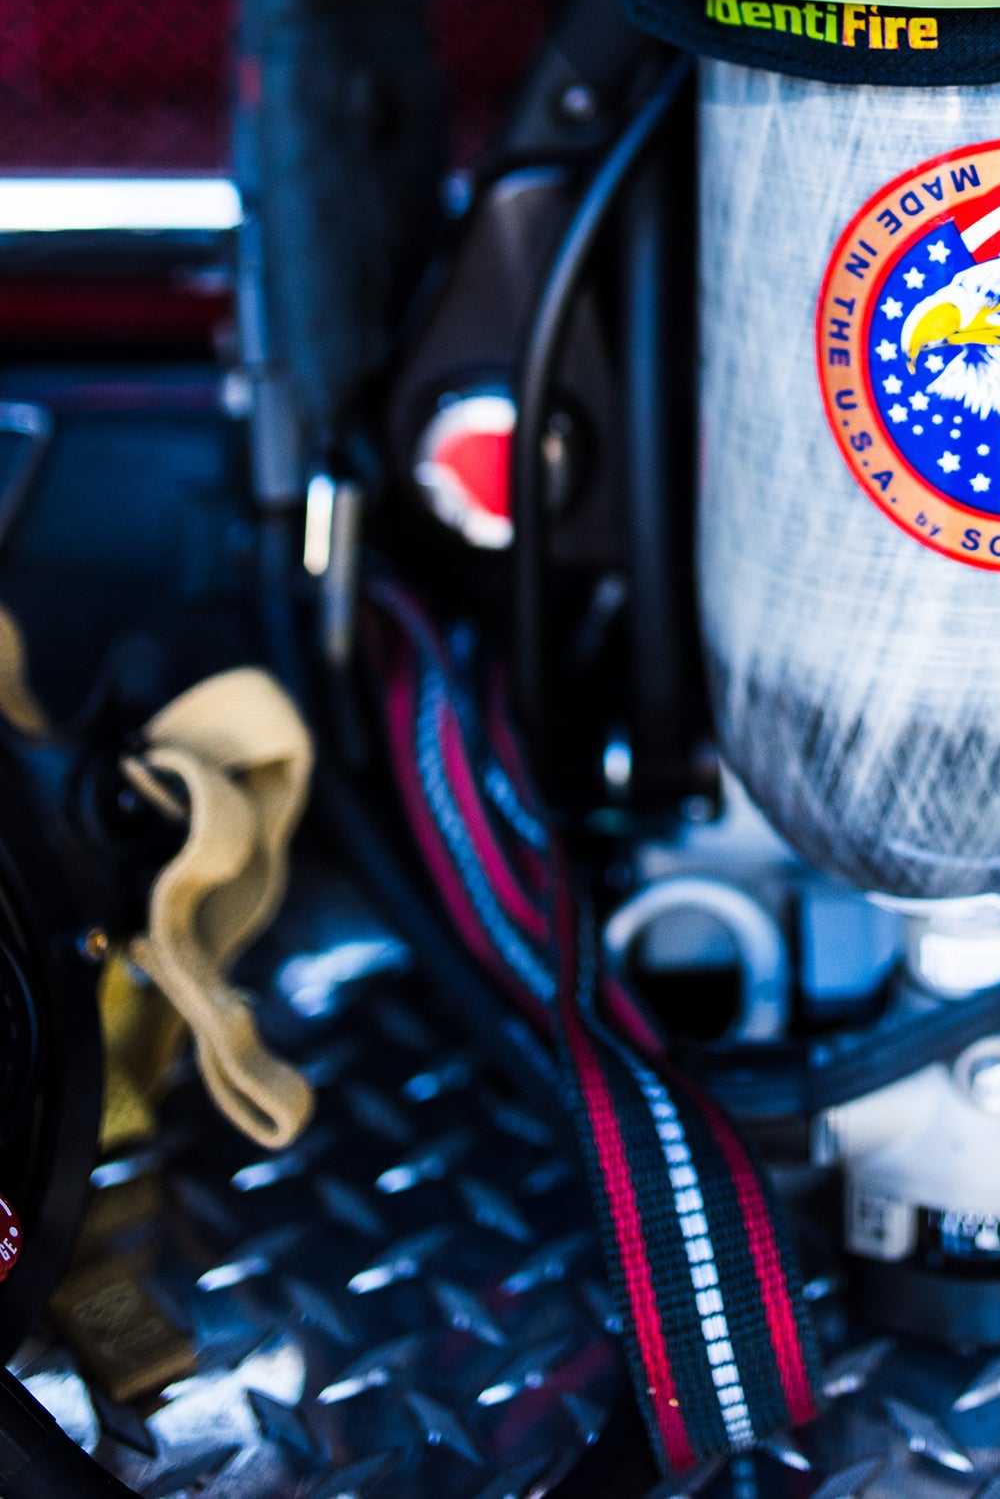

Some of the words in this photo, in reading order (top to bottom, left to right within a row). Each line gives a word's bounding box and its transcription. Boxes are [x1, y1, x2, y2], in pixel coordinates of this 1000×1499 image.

[877, 164, 981, 235] MADE
[845, 239, 878, 279] IN
[828, 297, 856, 367] THE
[836, 389, 898, 503] U.S.A.
[914, 512, 942, 537] by
